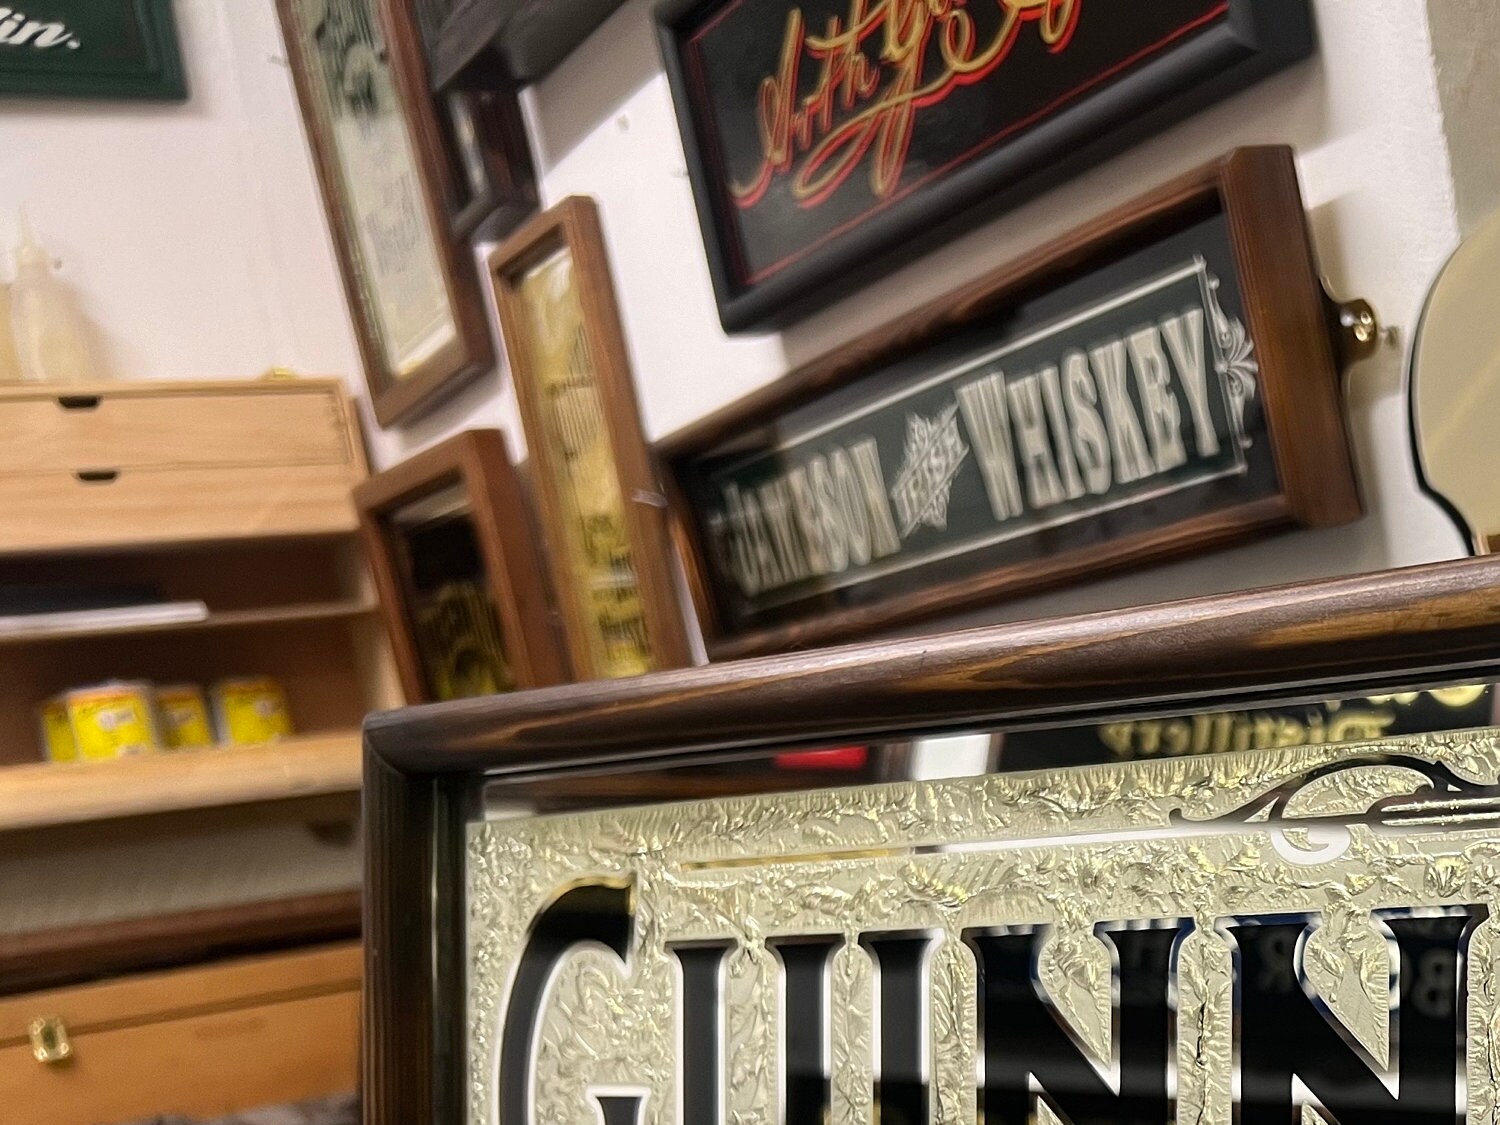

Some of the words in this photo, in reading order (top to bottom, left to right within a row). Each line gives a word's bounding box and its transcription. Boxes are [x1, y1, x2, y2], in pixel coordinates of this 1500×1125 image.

[0, 7, 81, 49] in.
[725, 434, 899, 597] JAMESON
[956, 308, 1221, 522] WHISKEY
